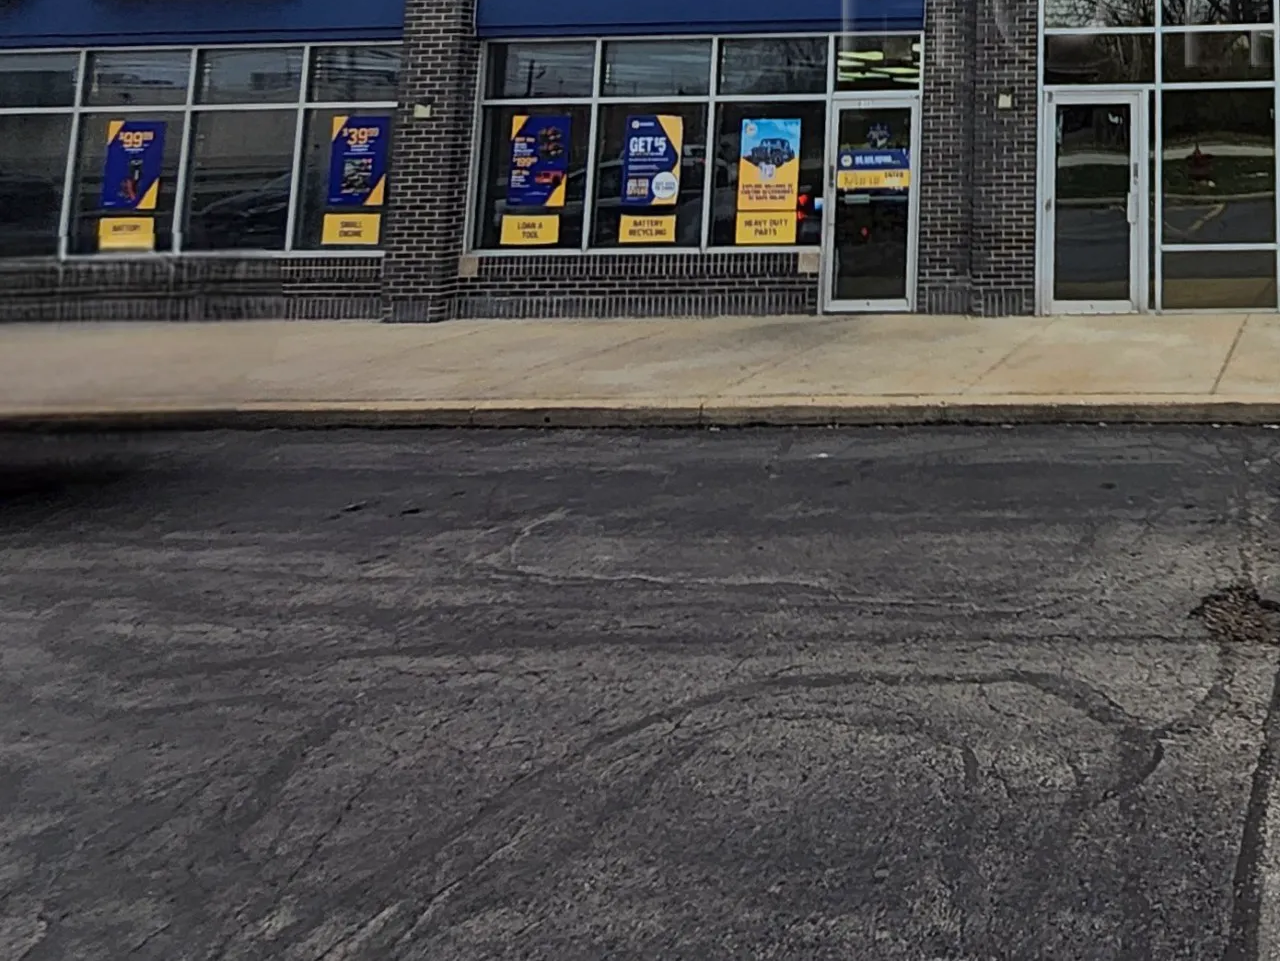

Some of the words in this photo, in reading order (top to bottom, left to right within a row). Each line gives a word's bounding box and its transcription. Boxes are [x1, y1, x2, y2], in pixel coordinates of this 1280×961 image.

[629, 136, 654, 154] GET
[517, 221, 535, 230] LOAN
[632, 219, 664, 228] BATTERY
[743, 219, 769, 228] HEAVY
